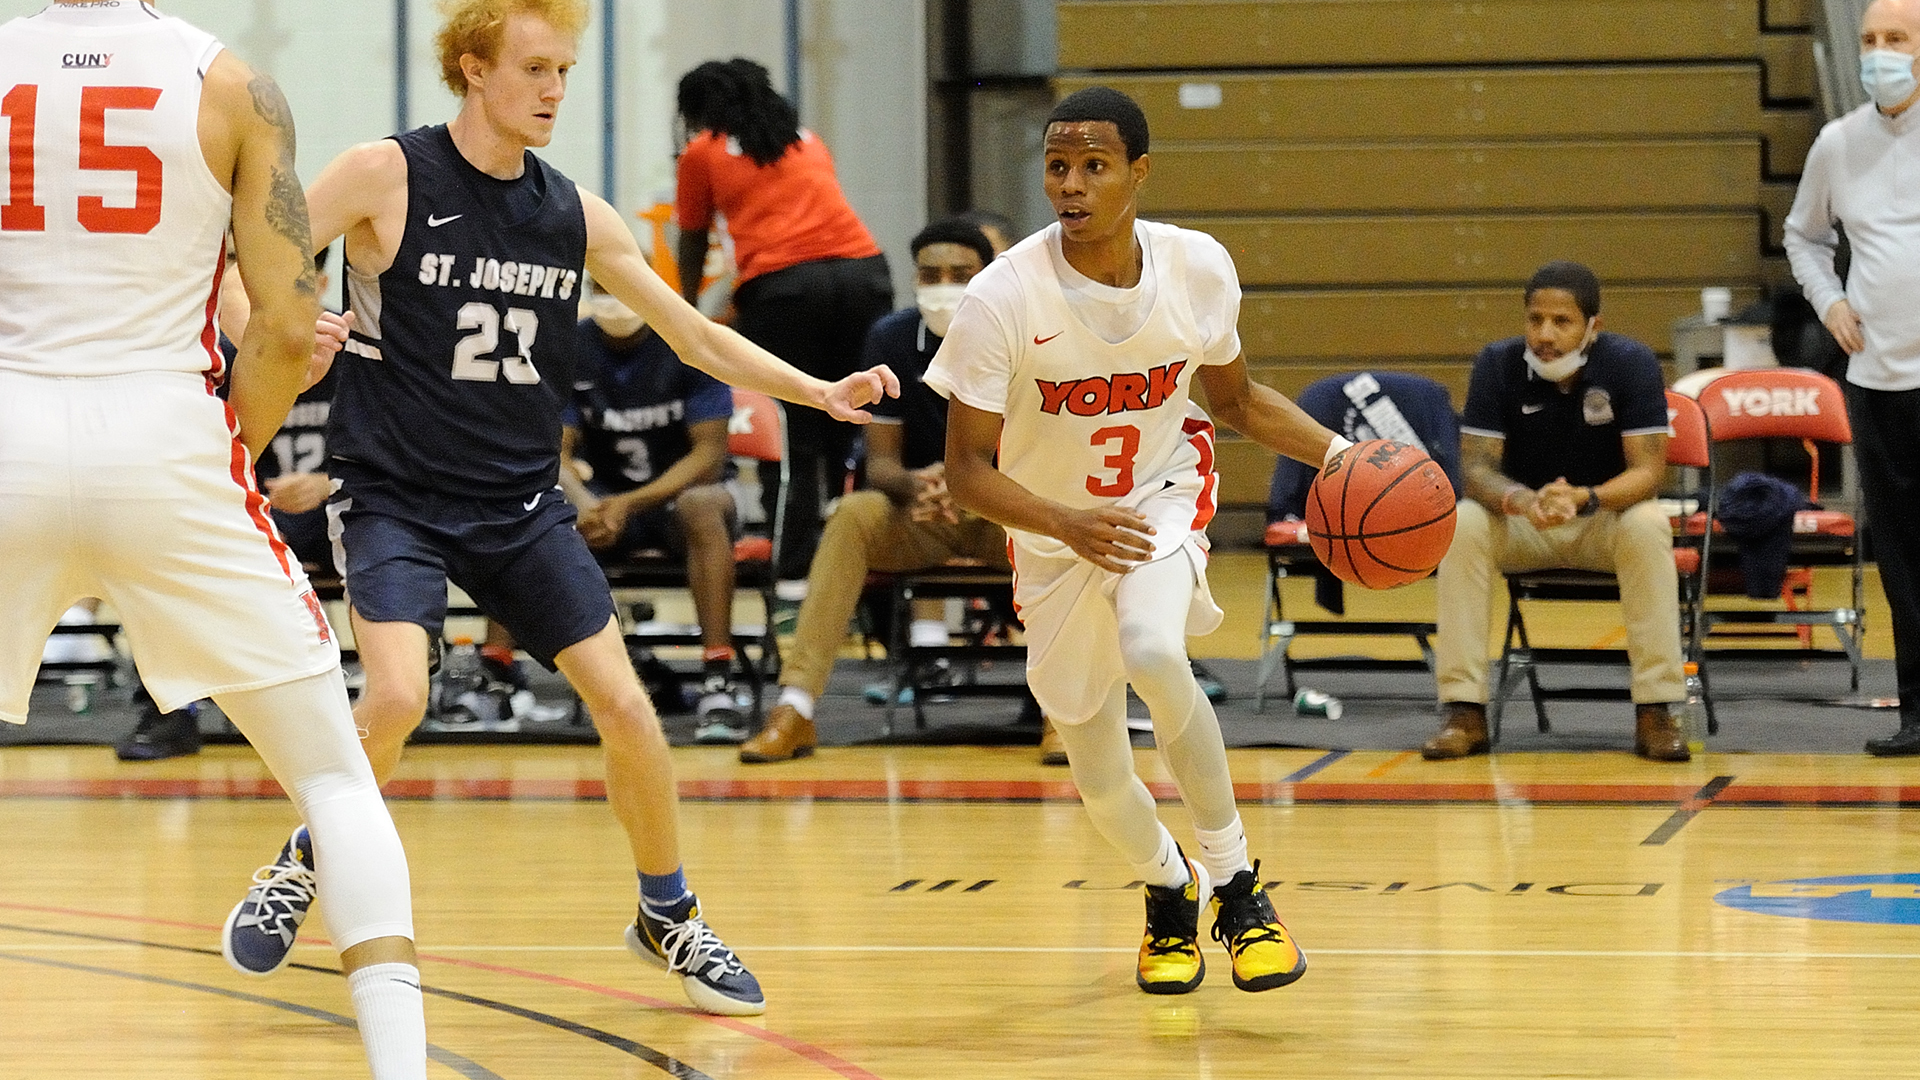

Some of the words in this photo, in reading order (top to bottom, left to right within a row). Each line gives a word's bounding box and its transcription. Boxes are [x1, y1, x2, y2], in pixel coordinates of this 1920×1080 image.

[62, 53, 113, 68] CUNY
[0, 83, 164, 234] 15
[418, 252, 461, 288] ST.
[469, 256, 578, 301] JOSEPH'S
[451, 301, 541, 386] 23
[1035, 358, 1188, 417] YORK
[1721, 387, 1820, 417] YORK
[271, 432, 326, 475] 12
[615, 436, 652, 482] 3
[1085, 424, 1141, 498] 3
